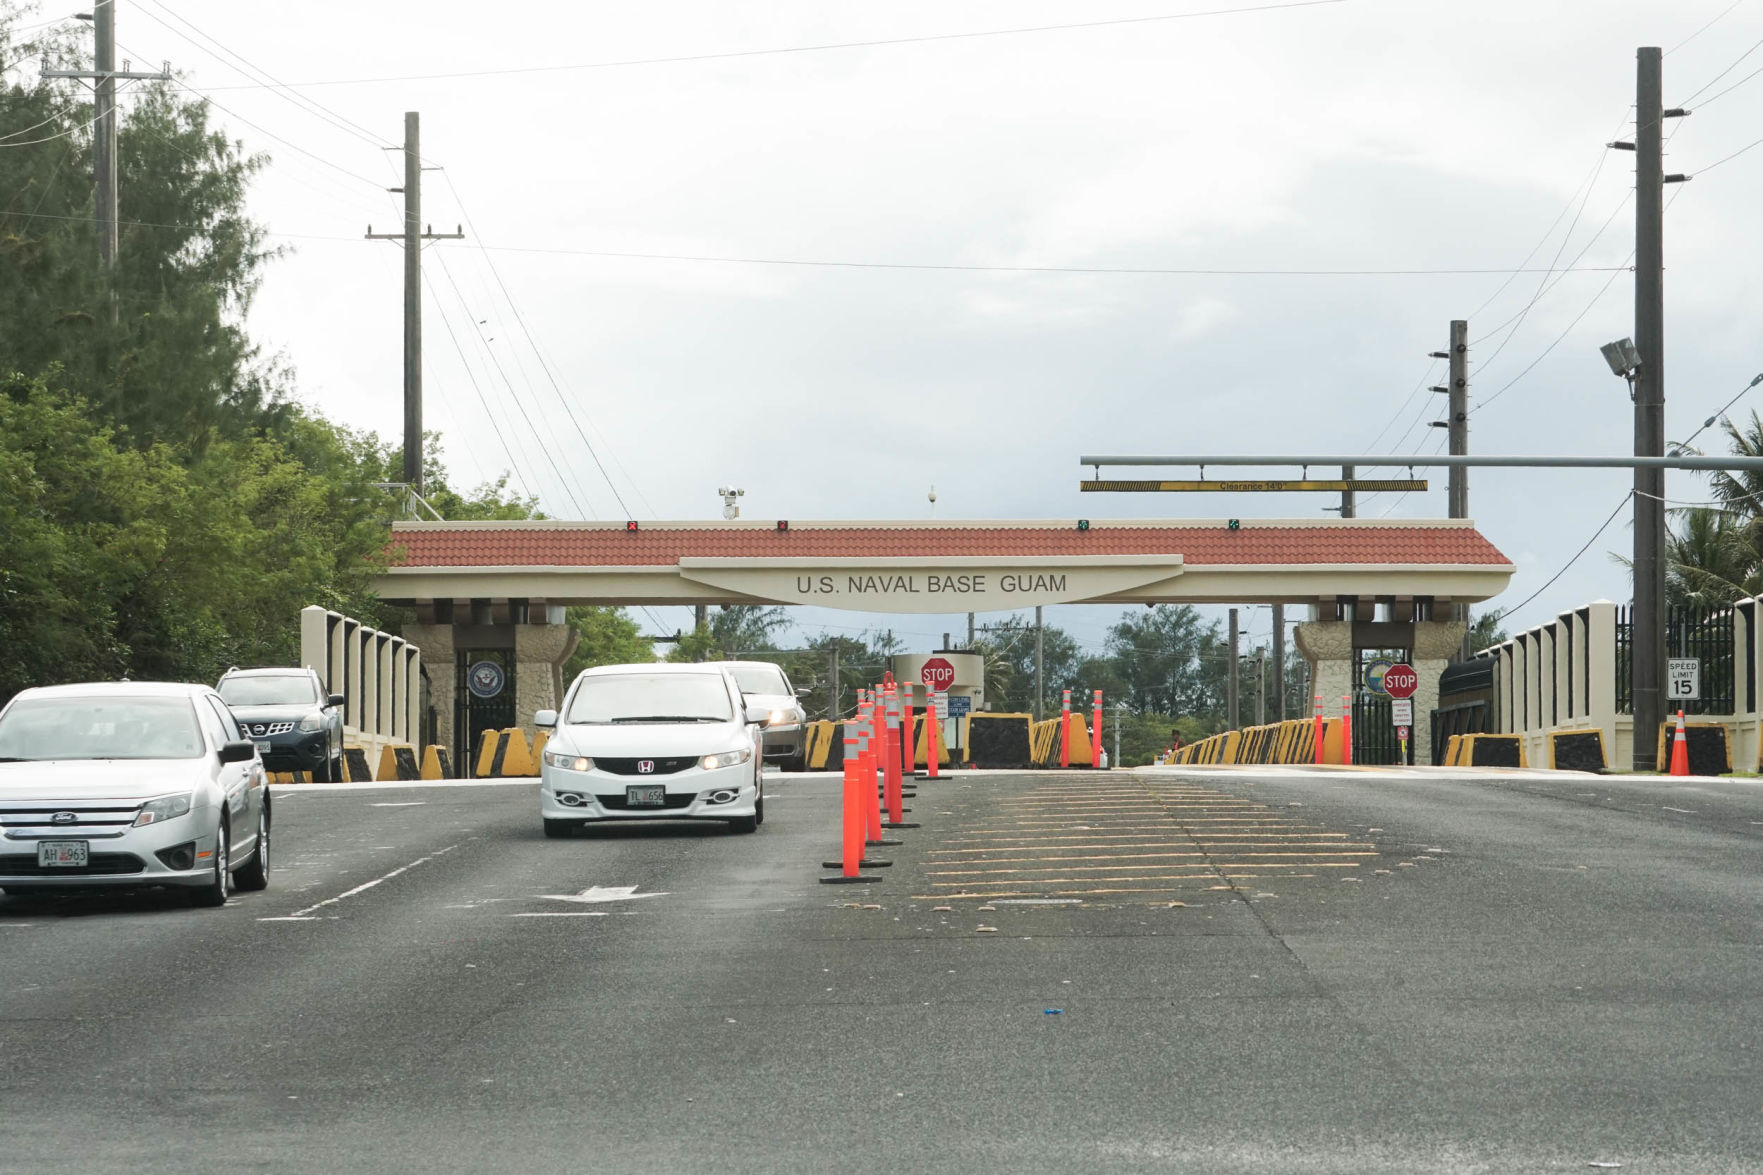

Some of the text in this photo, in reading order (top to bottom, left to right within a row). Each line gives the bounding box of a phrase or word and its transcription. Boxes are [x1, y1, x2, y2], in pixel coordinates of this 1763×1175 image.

[1220, 482, 1262, 490] Clearance
[797, 575, 1066, 593] U.S. NAVAL BASE GUAM
[923, 668, 953, 681] STOP
[1386, 675, 1416, 688] STOP
[1674, 680, 1692, 695] 15
[44, 848, 86, 861] AH 963
